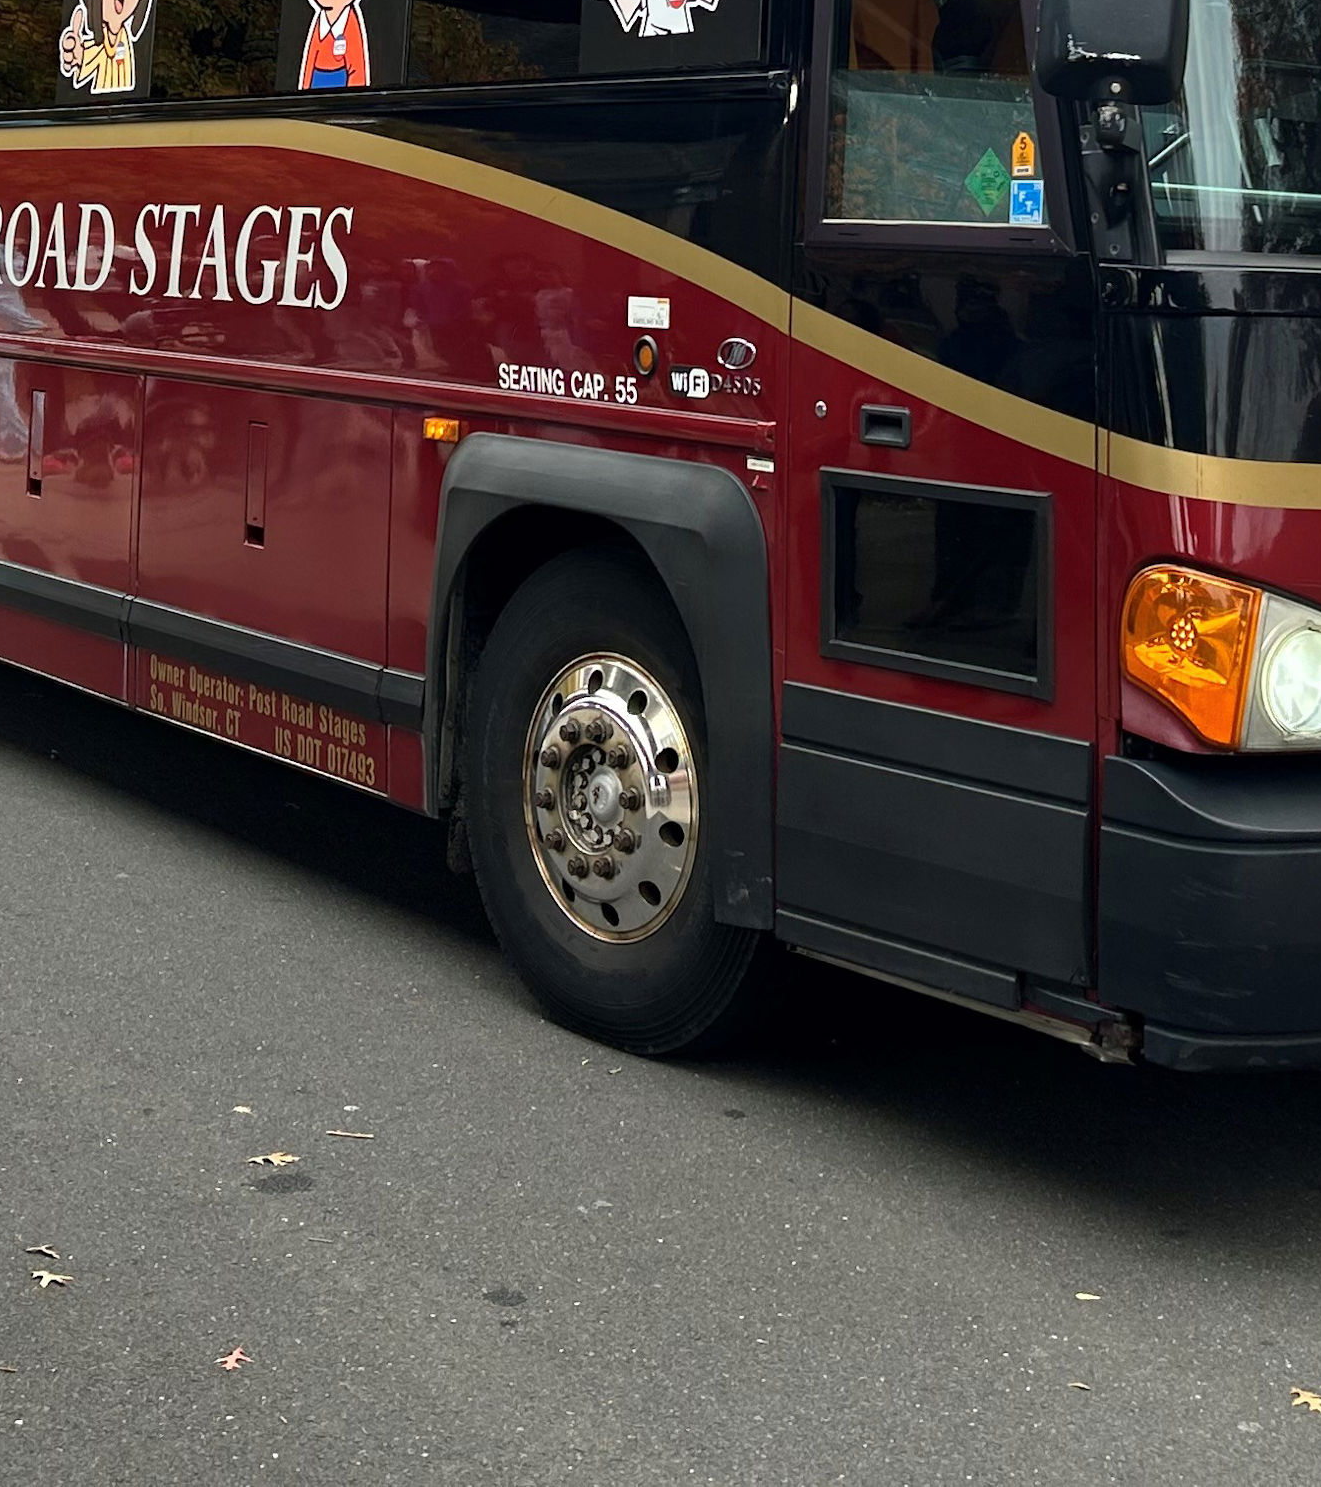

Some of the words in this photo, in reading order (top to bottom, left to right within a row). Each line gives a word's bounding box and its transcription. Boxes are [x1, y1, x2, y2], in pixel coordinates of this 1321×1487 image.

[1019, 137, 1027, 150] 5
[129, 204, 354, 311] STAGES
[498, 362, 565, 395] SEATING
[570, 371, 609, 401] CAP.
[615, 376, 638, 404] 55
[711, 373, 761, 396] D4505
[150, 653, 185, 688] Owner
[189, 665, 244, 707] Operator:
[249, 683, 277, 718] Post
[282, 694, 313, 729] Road
[319, 705, 366, 746] Stages
[150, 684, 168, 713] So.
[172, 691, 221, 732] Windsor,
[226, 708, 241, 737] CT
[275, 726, 292, 756] US
[298, 733, 322, 767] DOT
[327, 743, 375, 786] 017493
